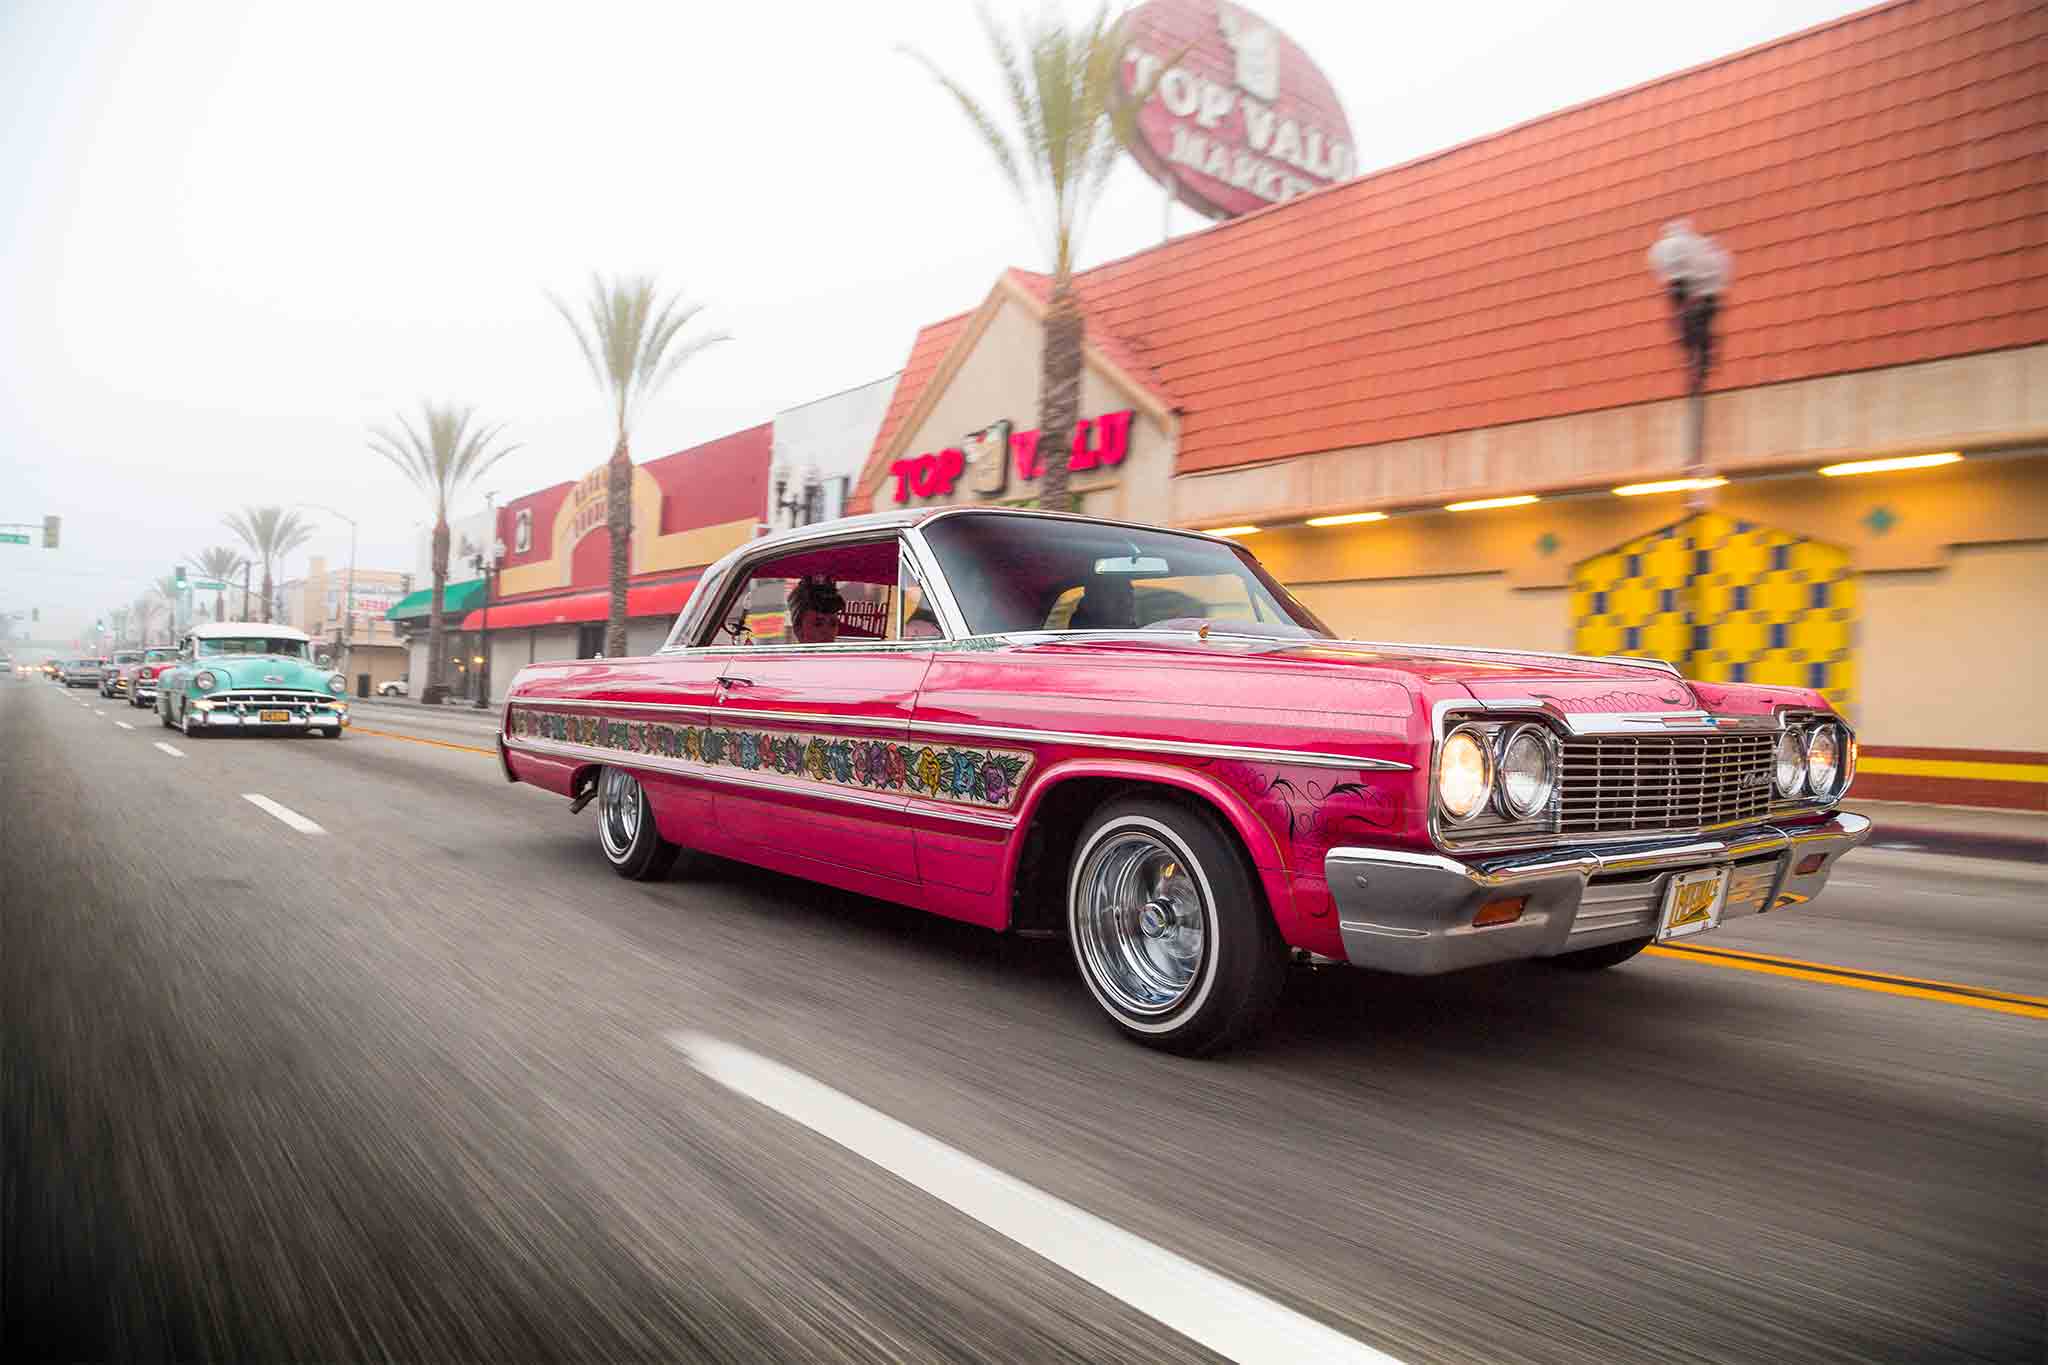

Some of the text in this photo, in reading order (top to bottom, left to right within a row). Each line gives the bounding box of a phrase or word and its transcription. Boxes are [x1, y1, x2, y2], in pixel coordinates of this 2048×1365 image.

[1121, 46, 1346, 179] TOP VALU
[1167, 125, 1314, 200] MARKE
[889, 409, 1134, 503] TOP VLU
